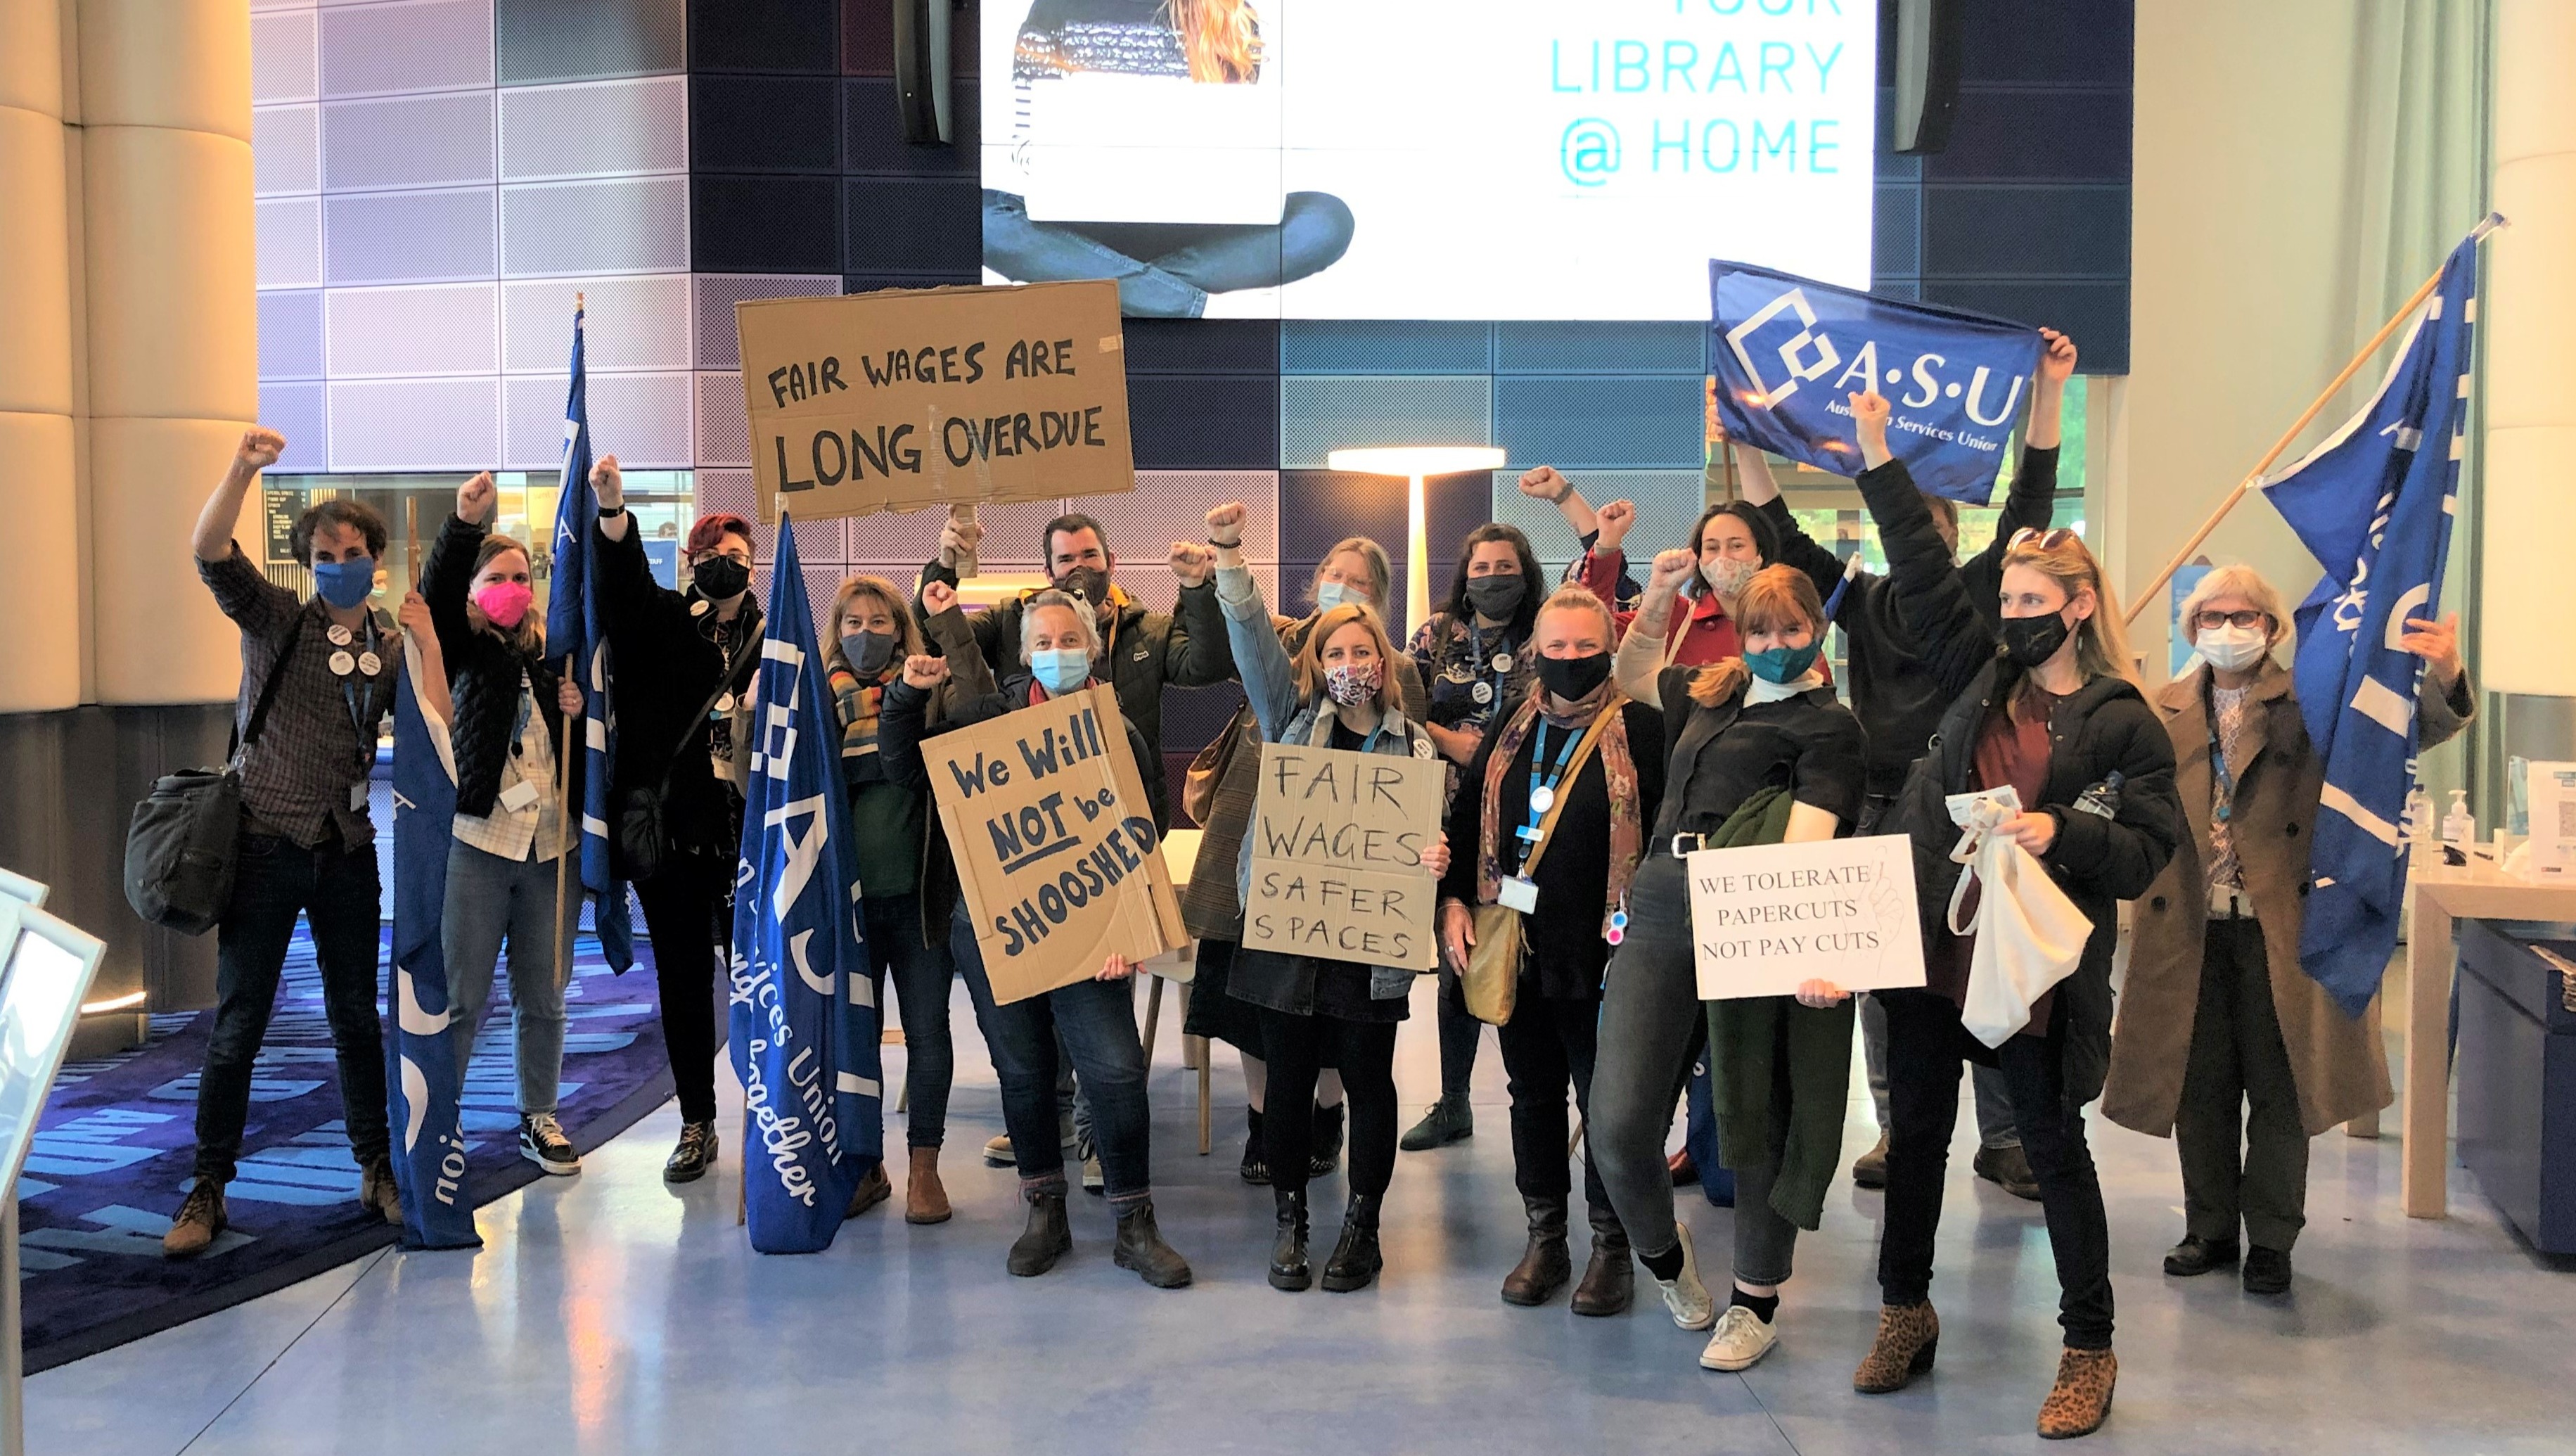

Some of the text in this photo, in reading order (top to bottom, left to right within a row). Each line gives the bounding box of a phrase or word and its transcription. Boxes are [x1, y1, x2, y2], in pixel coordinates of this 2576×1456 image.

[1552, 39, 1844, 94] LIBRARY
[1561, 117, 1840, 187] @ HOME
[769, 339, 1075, 408] FAIR WAGES ARE
[776, 406, 1106, 492] LONG OVERDUE
[1895, 416, 1954, 442] Services
[948, 709, 1101, 798] We Will
[1269, 756, 1409, 820] FAIR
[987, 788, 1115, 862] NOT be
[1264, 815, 1424, 868] WAGES
[996, 816, 1156, 957] SHOOSHED
[1261, 872, 1414, 924] SAFER
[1699, 865, 1871, 895] WE TOLERATE
[1255, 914, 1413, 959] SPACES
[1717, 900, 1857, 926] PAPERCUTS
[1703, 931, 1879, 961] NOT PAY CUTS
[787, 1045, 842, 1167] Union
